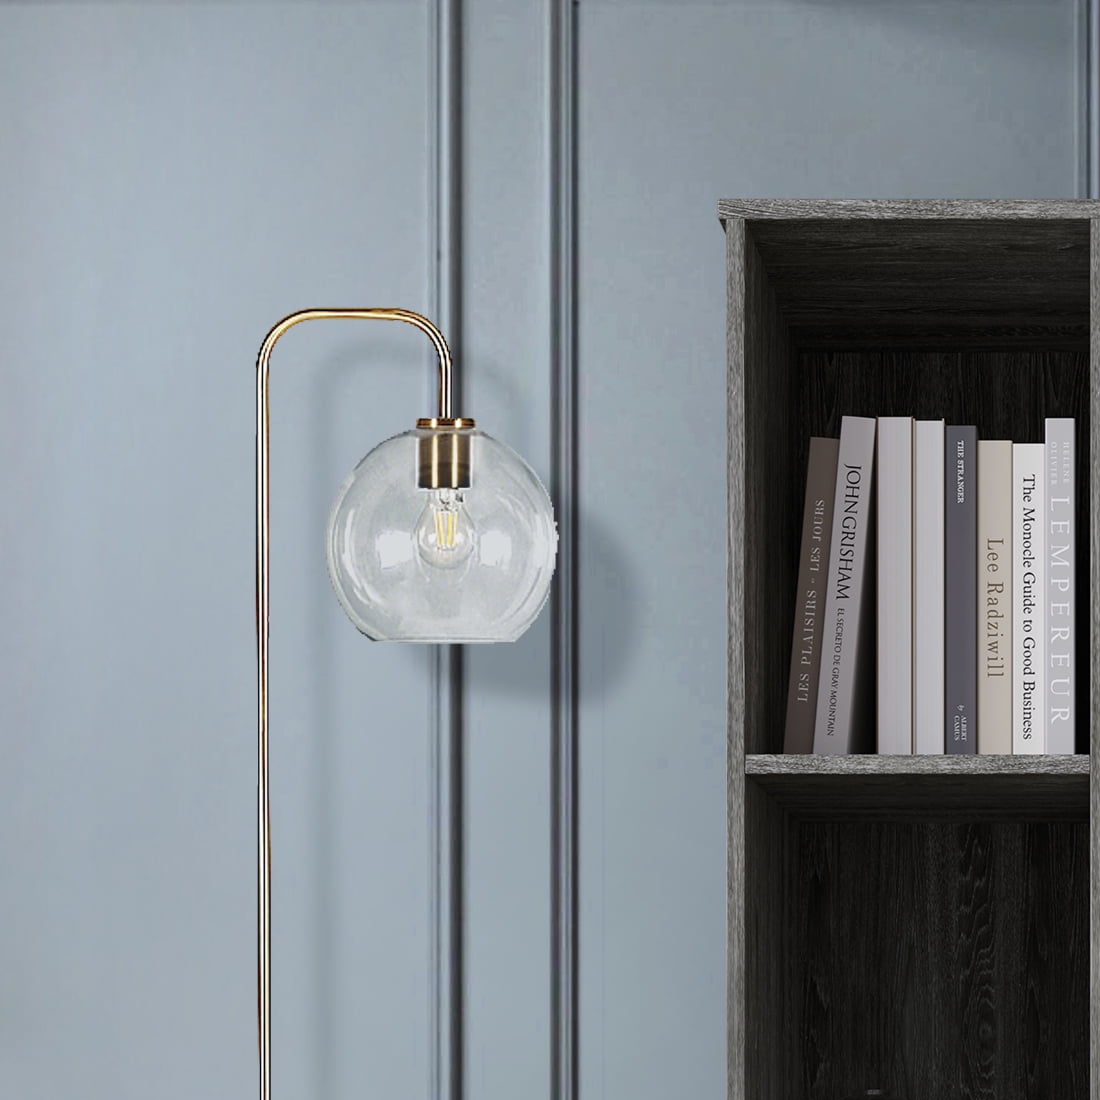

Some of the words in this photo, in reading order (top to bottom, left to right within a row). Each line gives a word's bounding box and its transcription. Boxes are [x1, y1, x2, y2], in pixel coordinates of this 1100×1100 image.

[1022, 473, 1036, 503] The
[812, 499, 825, 542] JOURS
[1022, 507, 1036, 568] Monocle
[809, 547, 821, 572] LES
[986, 538, 1004, 573] Lee
[837, 608, 845, 616] EL
[1022, 572, 1036, 615] Guide
[1050, 496, 1071, 726] LEMPEREUR
[800, 589, 817, 665] PLAISIRS
[834, 618, 844, 653] SECRETO
[986, 581, 1005, 679] Radziwill
[1022, 619, 1034, 633] to
[833, 654, 840, 665] DE
[1022, 636, 1036, 676] Good
[797, 673, 809, 703] LES
[831, 667, 839, 689] GRAY
[827, 689, 837, 737] MOUNTAIN
[1022, 680, 1036, 740] Business
